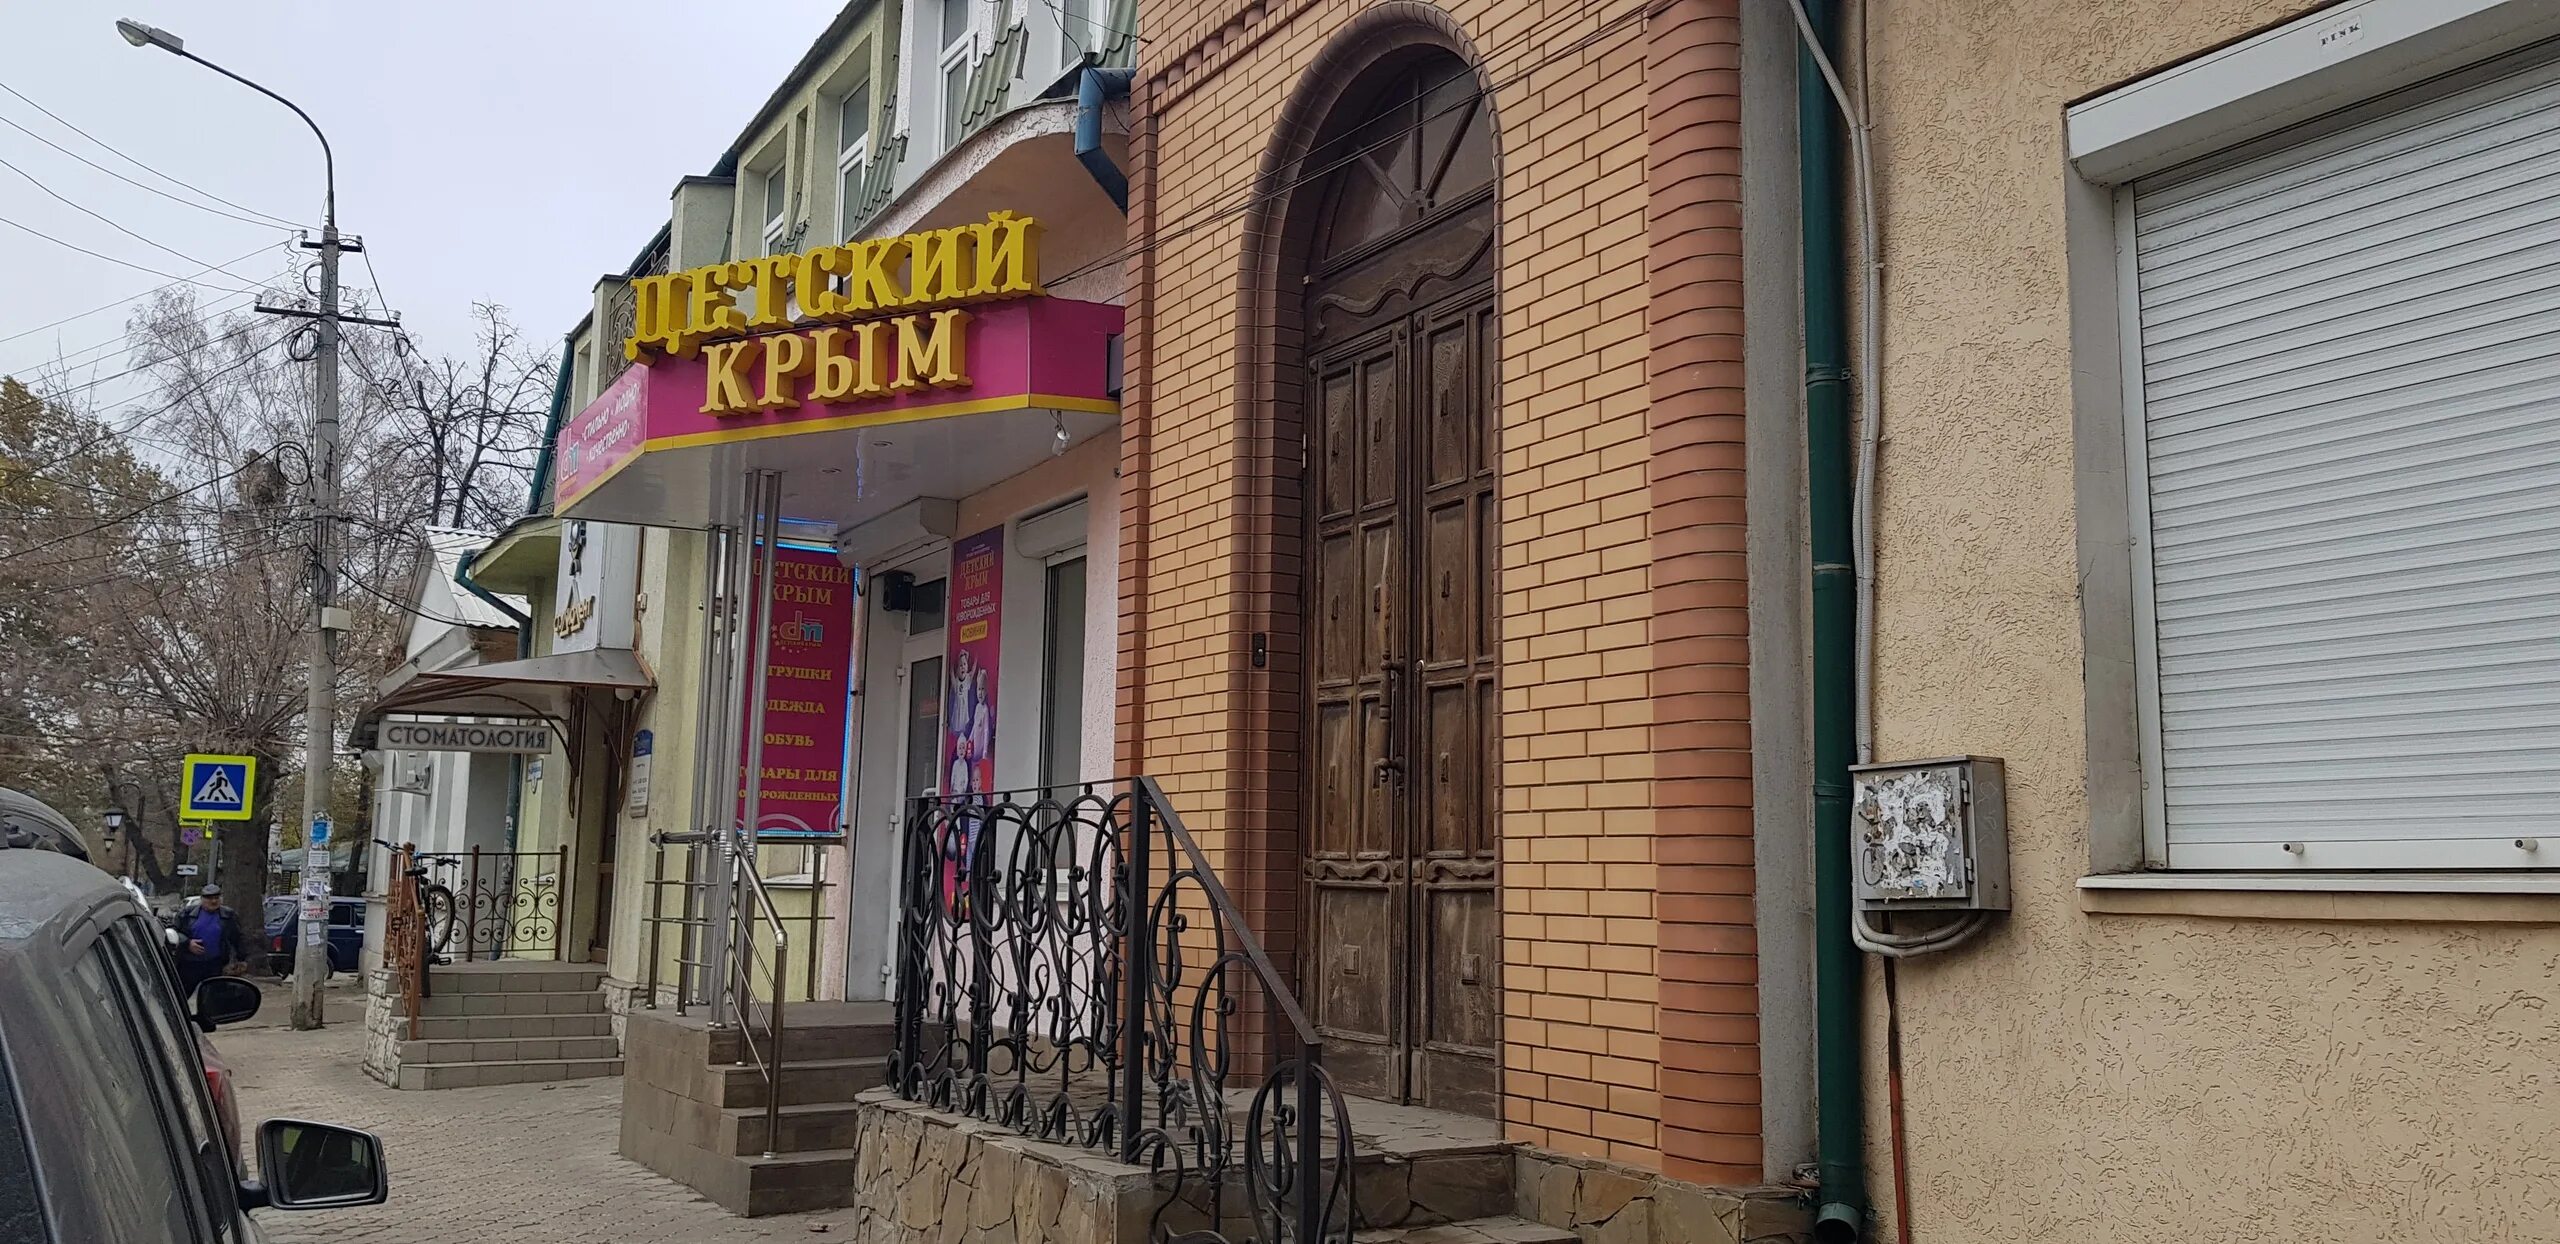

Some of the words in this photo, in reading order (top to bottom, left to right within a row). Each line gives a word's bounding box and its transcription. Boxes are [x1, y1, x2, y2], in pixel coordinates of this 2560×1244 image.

[624, 209, 1046, 365] ДЕТСКИЙ
[698, 310, 973, 417] КРЫМ
[767, 665, 832, 681] ГРУШКИ
[766, 699, 825, 714] ДЕЖДА
[387, 725, 547, 748] СТОМАТОЛОГИЯ
[764, 733, 815, 747] ОБУВЬ
[804, 769, 838, 782] ДЛЯ
